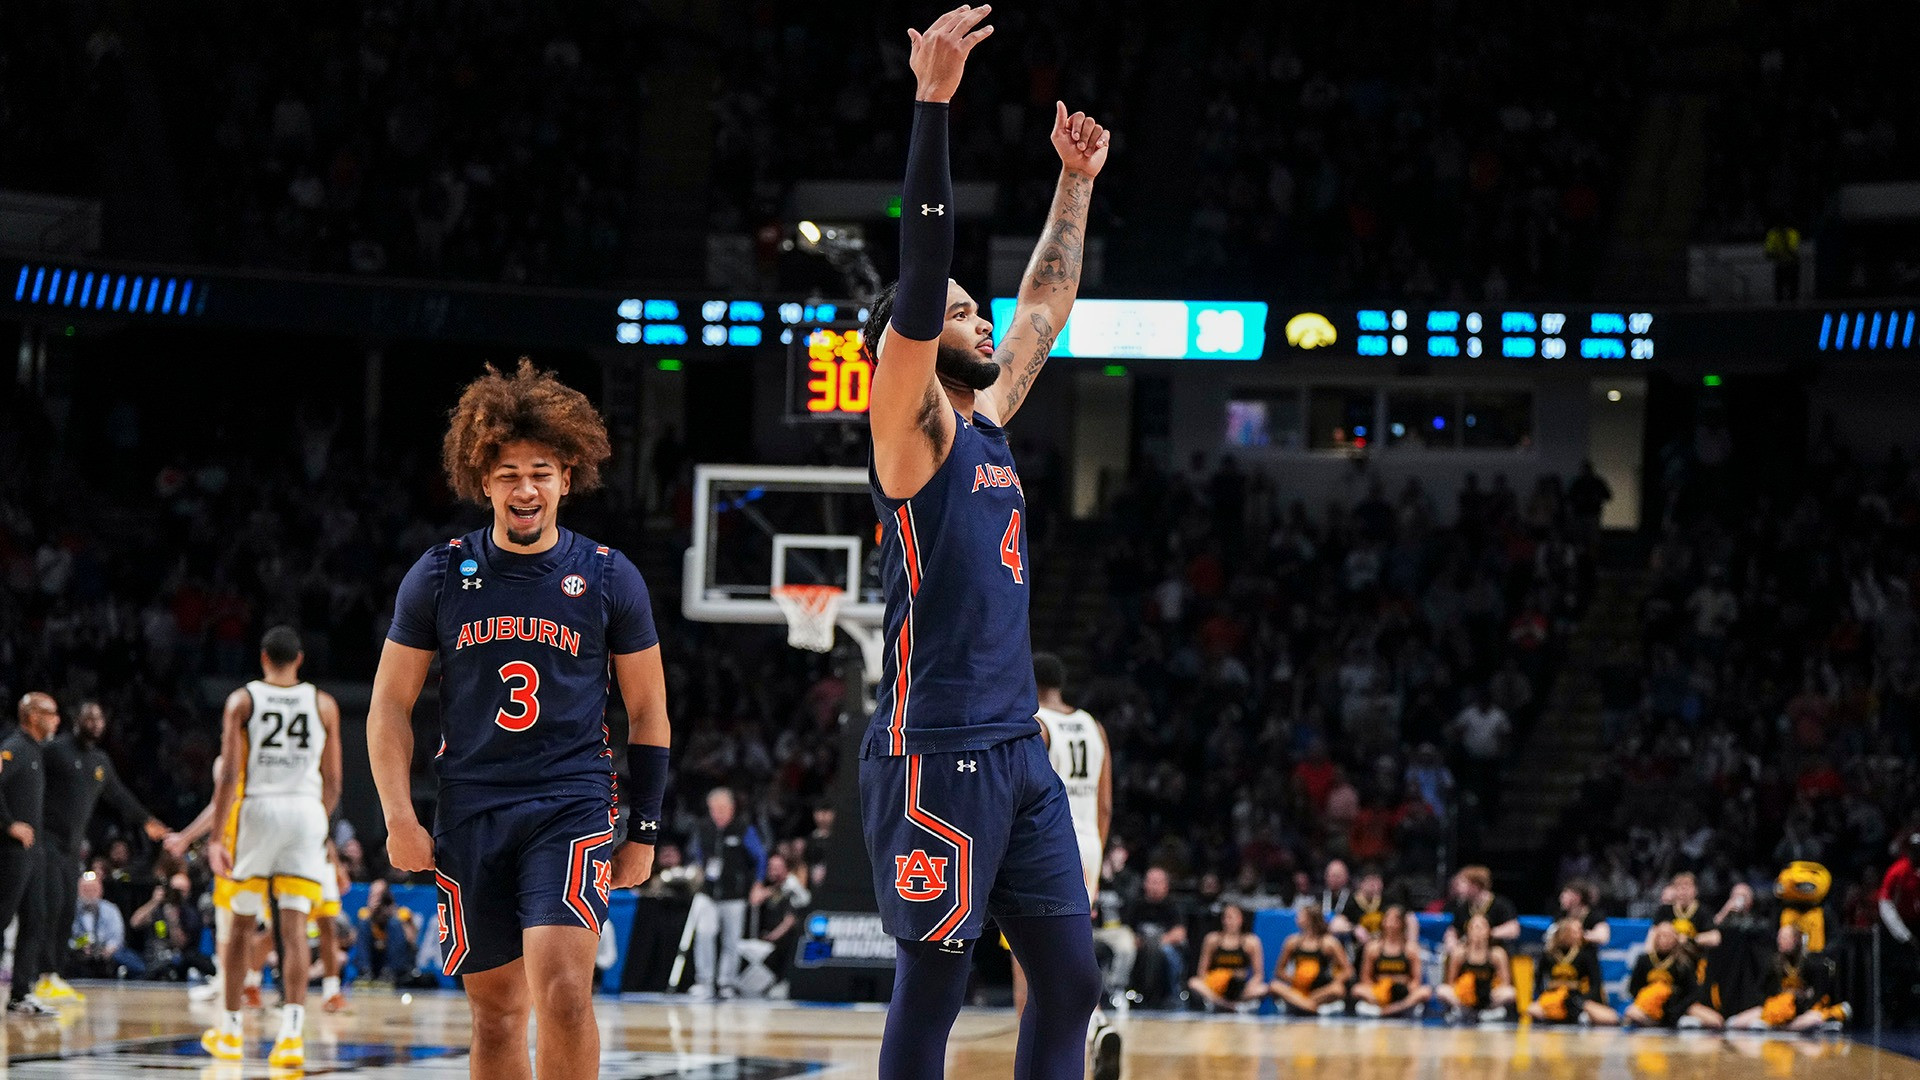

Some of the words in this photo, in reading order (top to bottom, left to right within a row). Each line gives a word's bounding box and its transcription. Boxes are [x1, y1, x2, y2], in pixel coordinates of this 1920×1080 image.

[807, 359, 871, 412] 30
[971, 463, 1022, 495] AUBU
[1000, 508, 1023, 585] 4
[563, 575, 585, 596] SEC
[456, 616, 580, 657] AUBURN
[495, 660, 540, 732] 3
[260, 711, 310, 748] 24
[1069, 739, 1088, 778] 11
